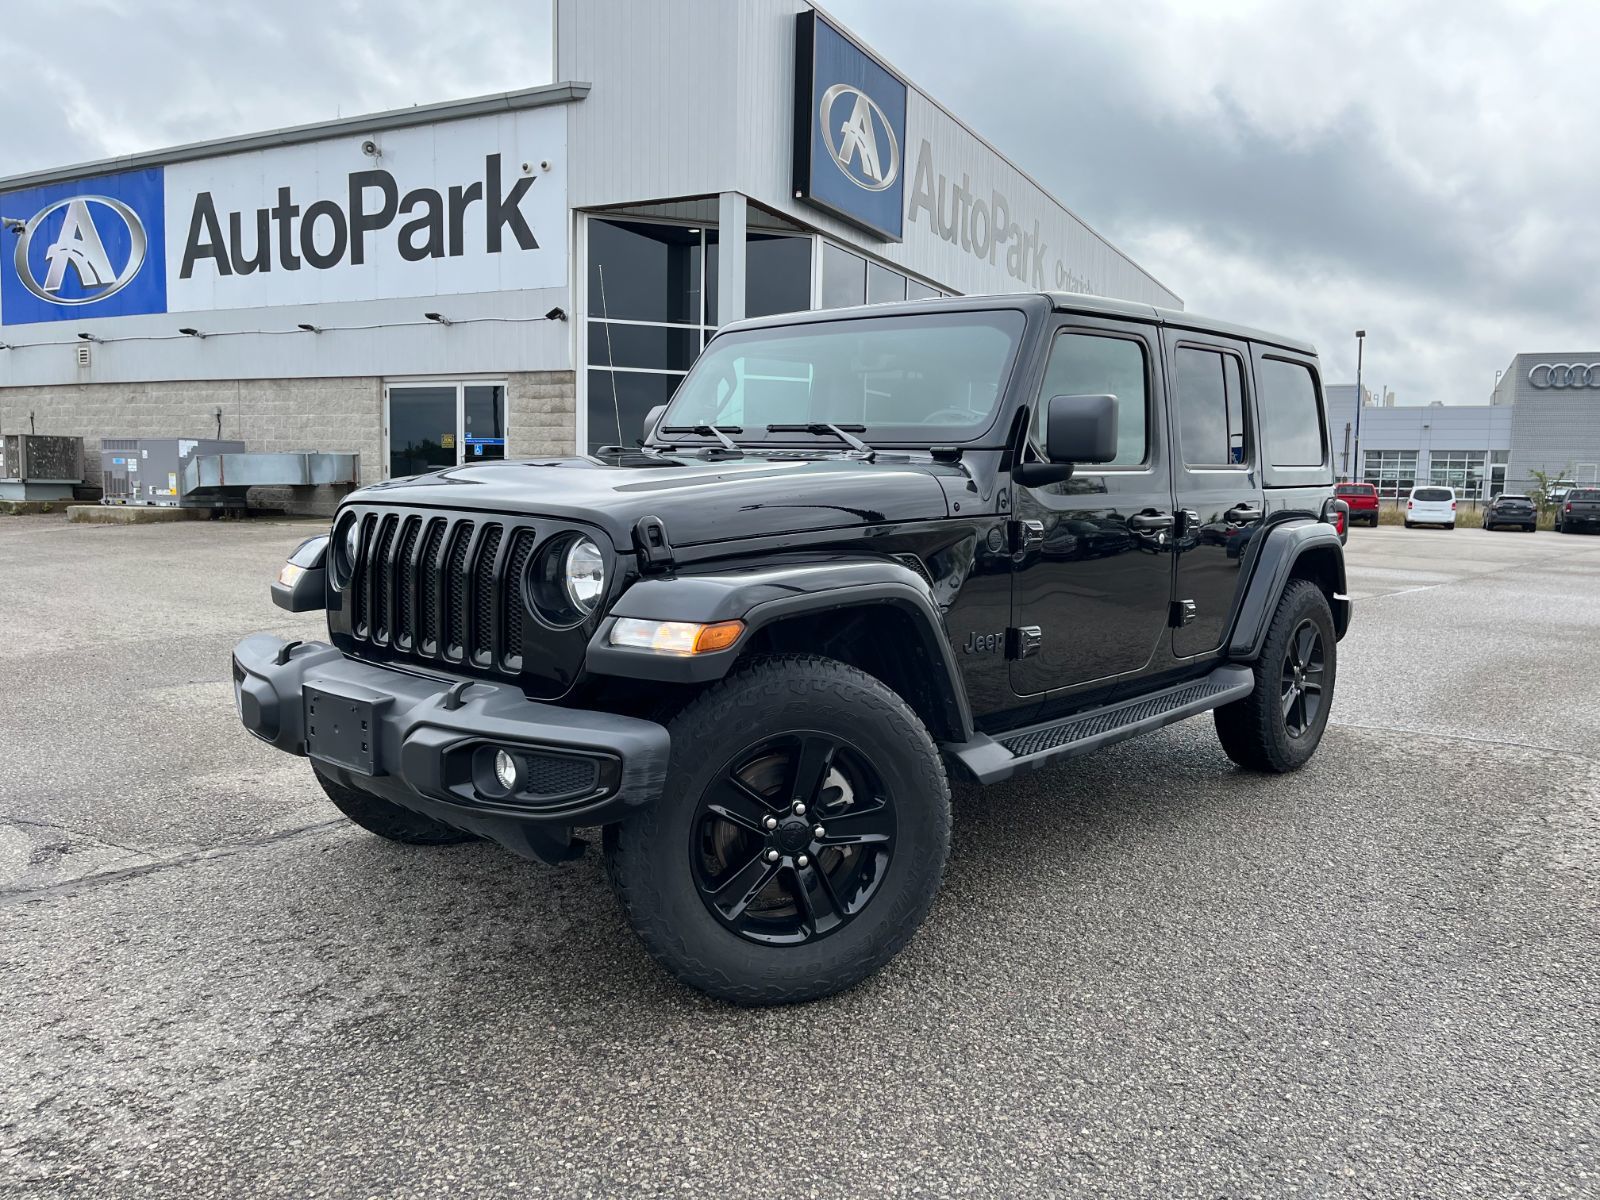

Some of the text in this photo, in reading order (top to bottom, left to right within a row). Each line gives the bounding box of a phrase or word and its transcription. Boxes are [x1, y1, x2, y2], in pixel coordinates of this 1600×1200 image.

[179, 153, 540, 279] AutoPark
[908, 138, 1047, 291] AutoPark
[963, 631, 1005, 655] Jeep
